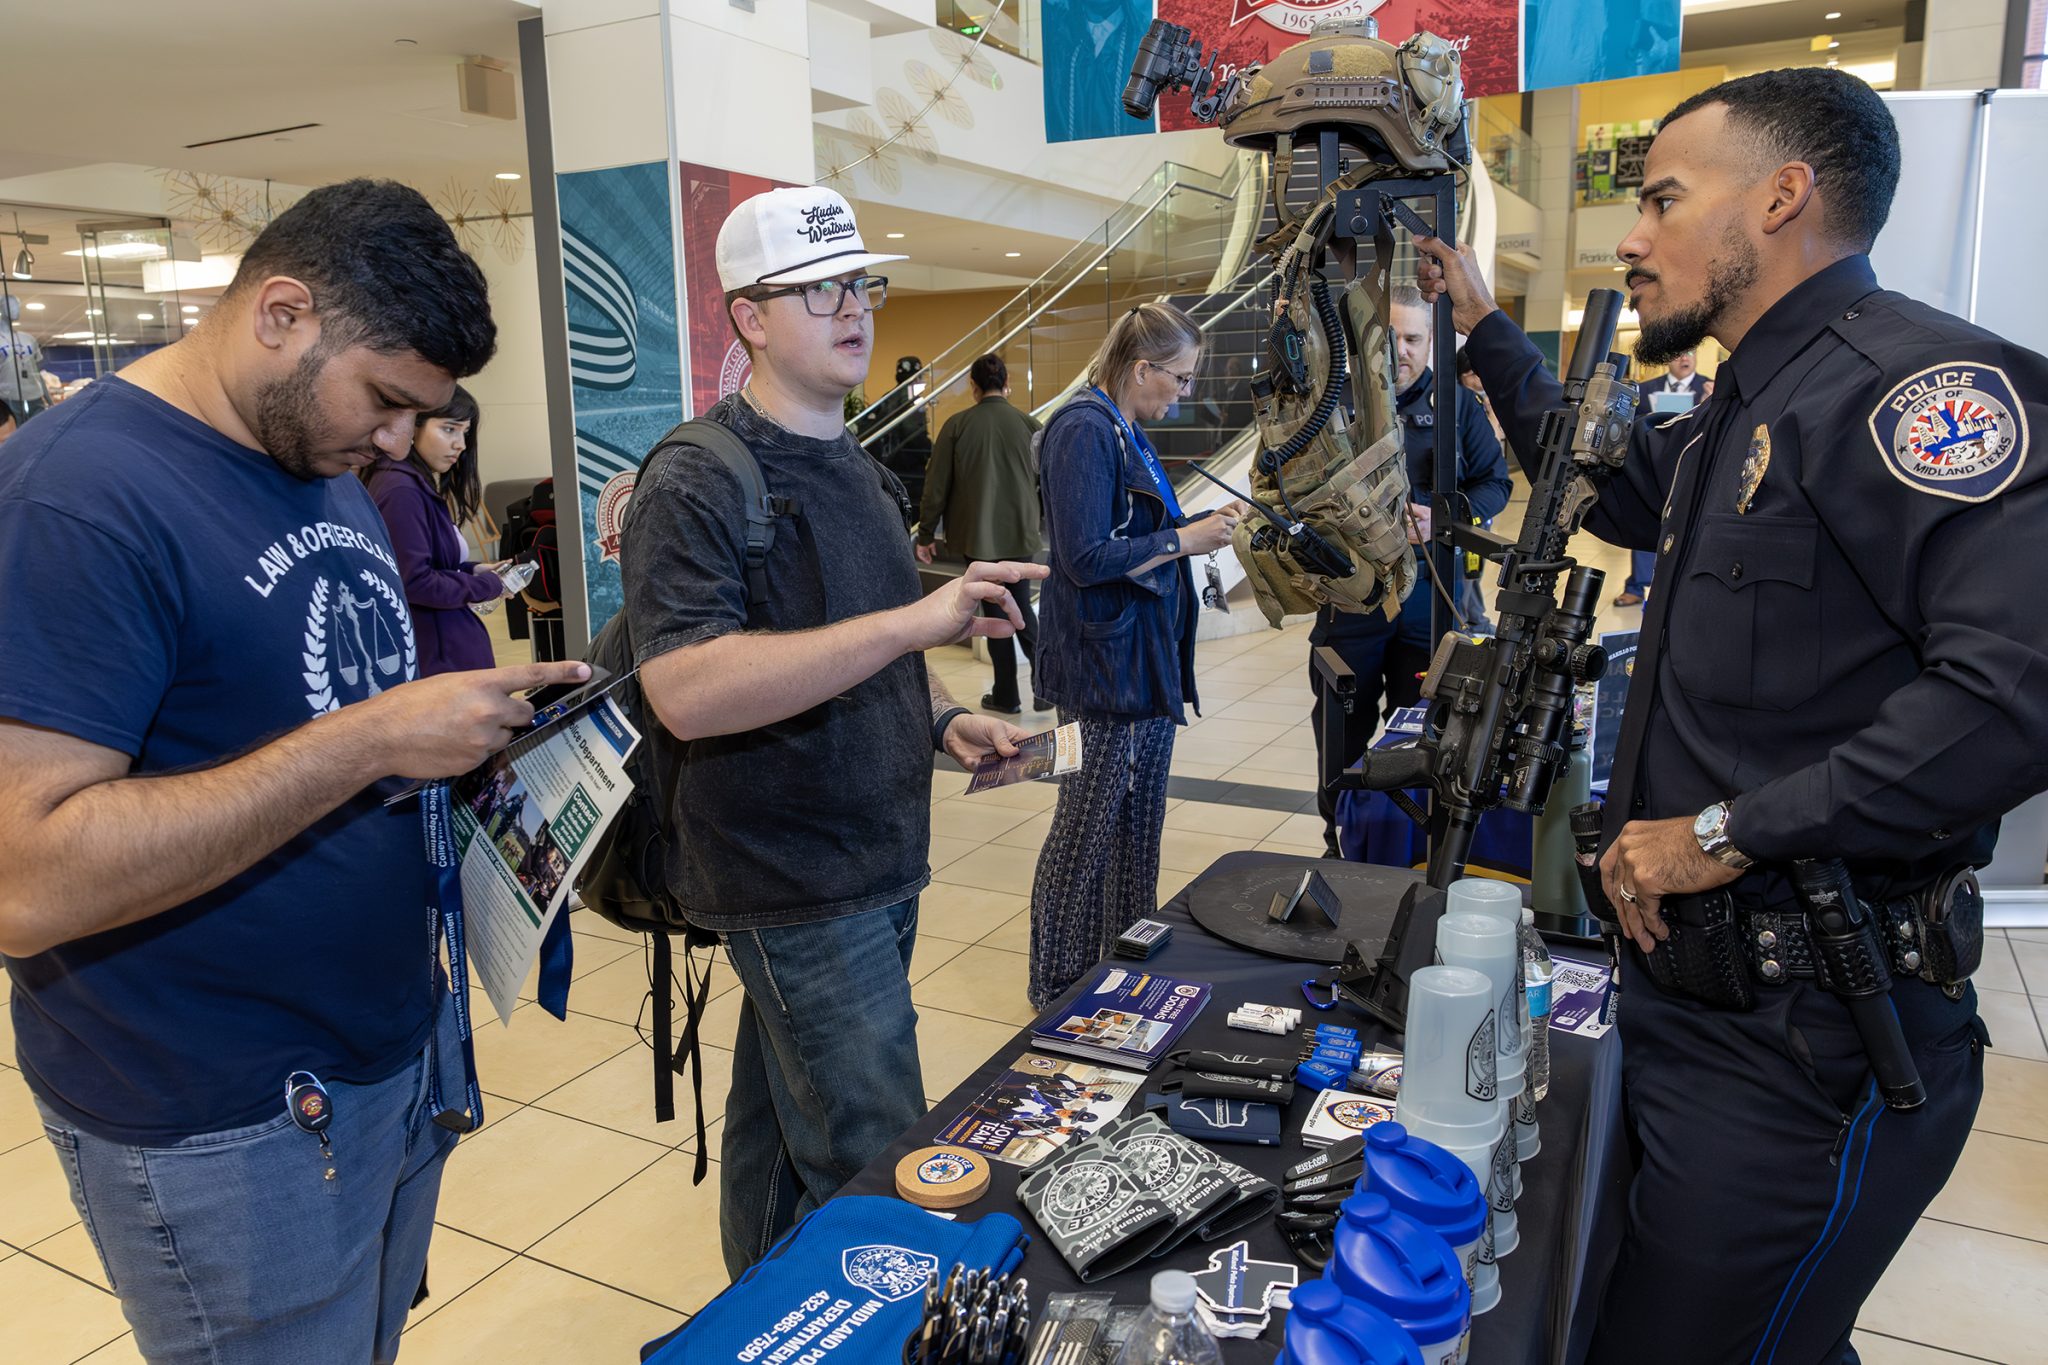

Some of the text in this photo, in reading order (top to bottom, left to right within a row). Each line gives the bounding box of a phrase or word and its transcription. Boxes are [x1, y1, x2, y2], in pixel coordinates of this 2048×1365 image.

[1281, 11, 1316, 29] 1965
[1890, 371, 1976, 413] POLICE
[1911, 390, 1964, 414] CITY OF
[1913, 436, 2012, 476] MIDLAND TEXAS
[599, 496, 610, 532] TARRANT
[244, 541, 295, 599] LAW
[286, 533, 310, 559] &
[575, 739, 618, 792] Department
[572, 791, 597, 824] Contact
[428, 813, 439, 865] Department
[444, 912, 467, 1042] Colleyville Police Department
[1154, 995, 1181, 1020] DORMS
[967, 1121, 1000, 1145] TEAM
[985, 1123, 1014, 1147] JOIN
[939, 1154, 973, 1170] POLICE
[1157, 1163, 1195, 1198] POLIC
[1166, 1177, 1211, 1210] Departm
[1182, 1178, 1225, 1210] Midland
[1069, 1190, 1132, 1230] POLICE
[1094, 1192, 1113, 1207] CITY
[1075, 1205, 1158, 1258] Midland Police
[1078, 1204, 1145, 1248] Department
[888, 1260, 930, 1296] POLICE
[736, 1290, 831, 1363] 432-685-7590
[761, 1299, 852, 1365] DEPARTMENT
[819, 1299, 884, 1350] MIDLAND
